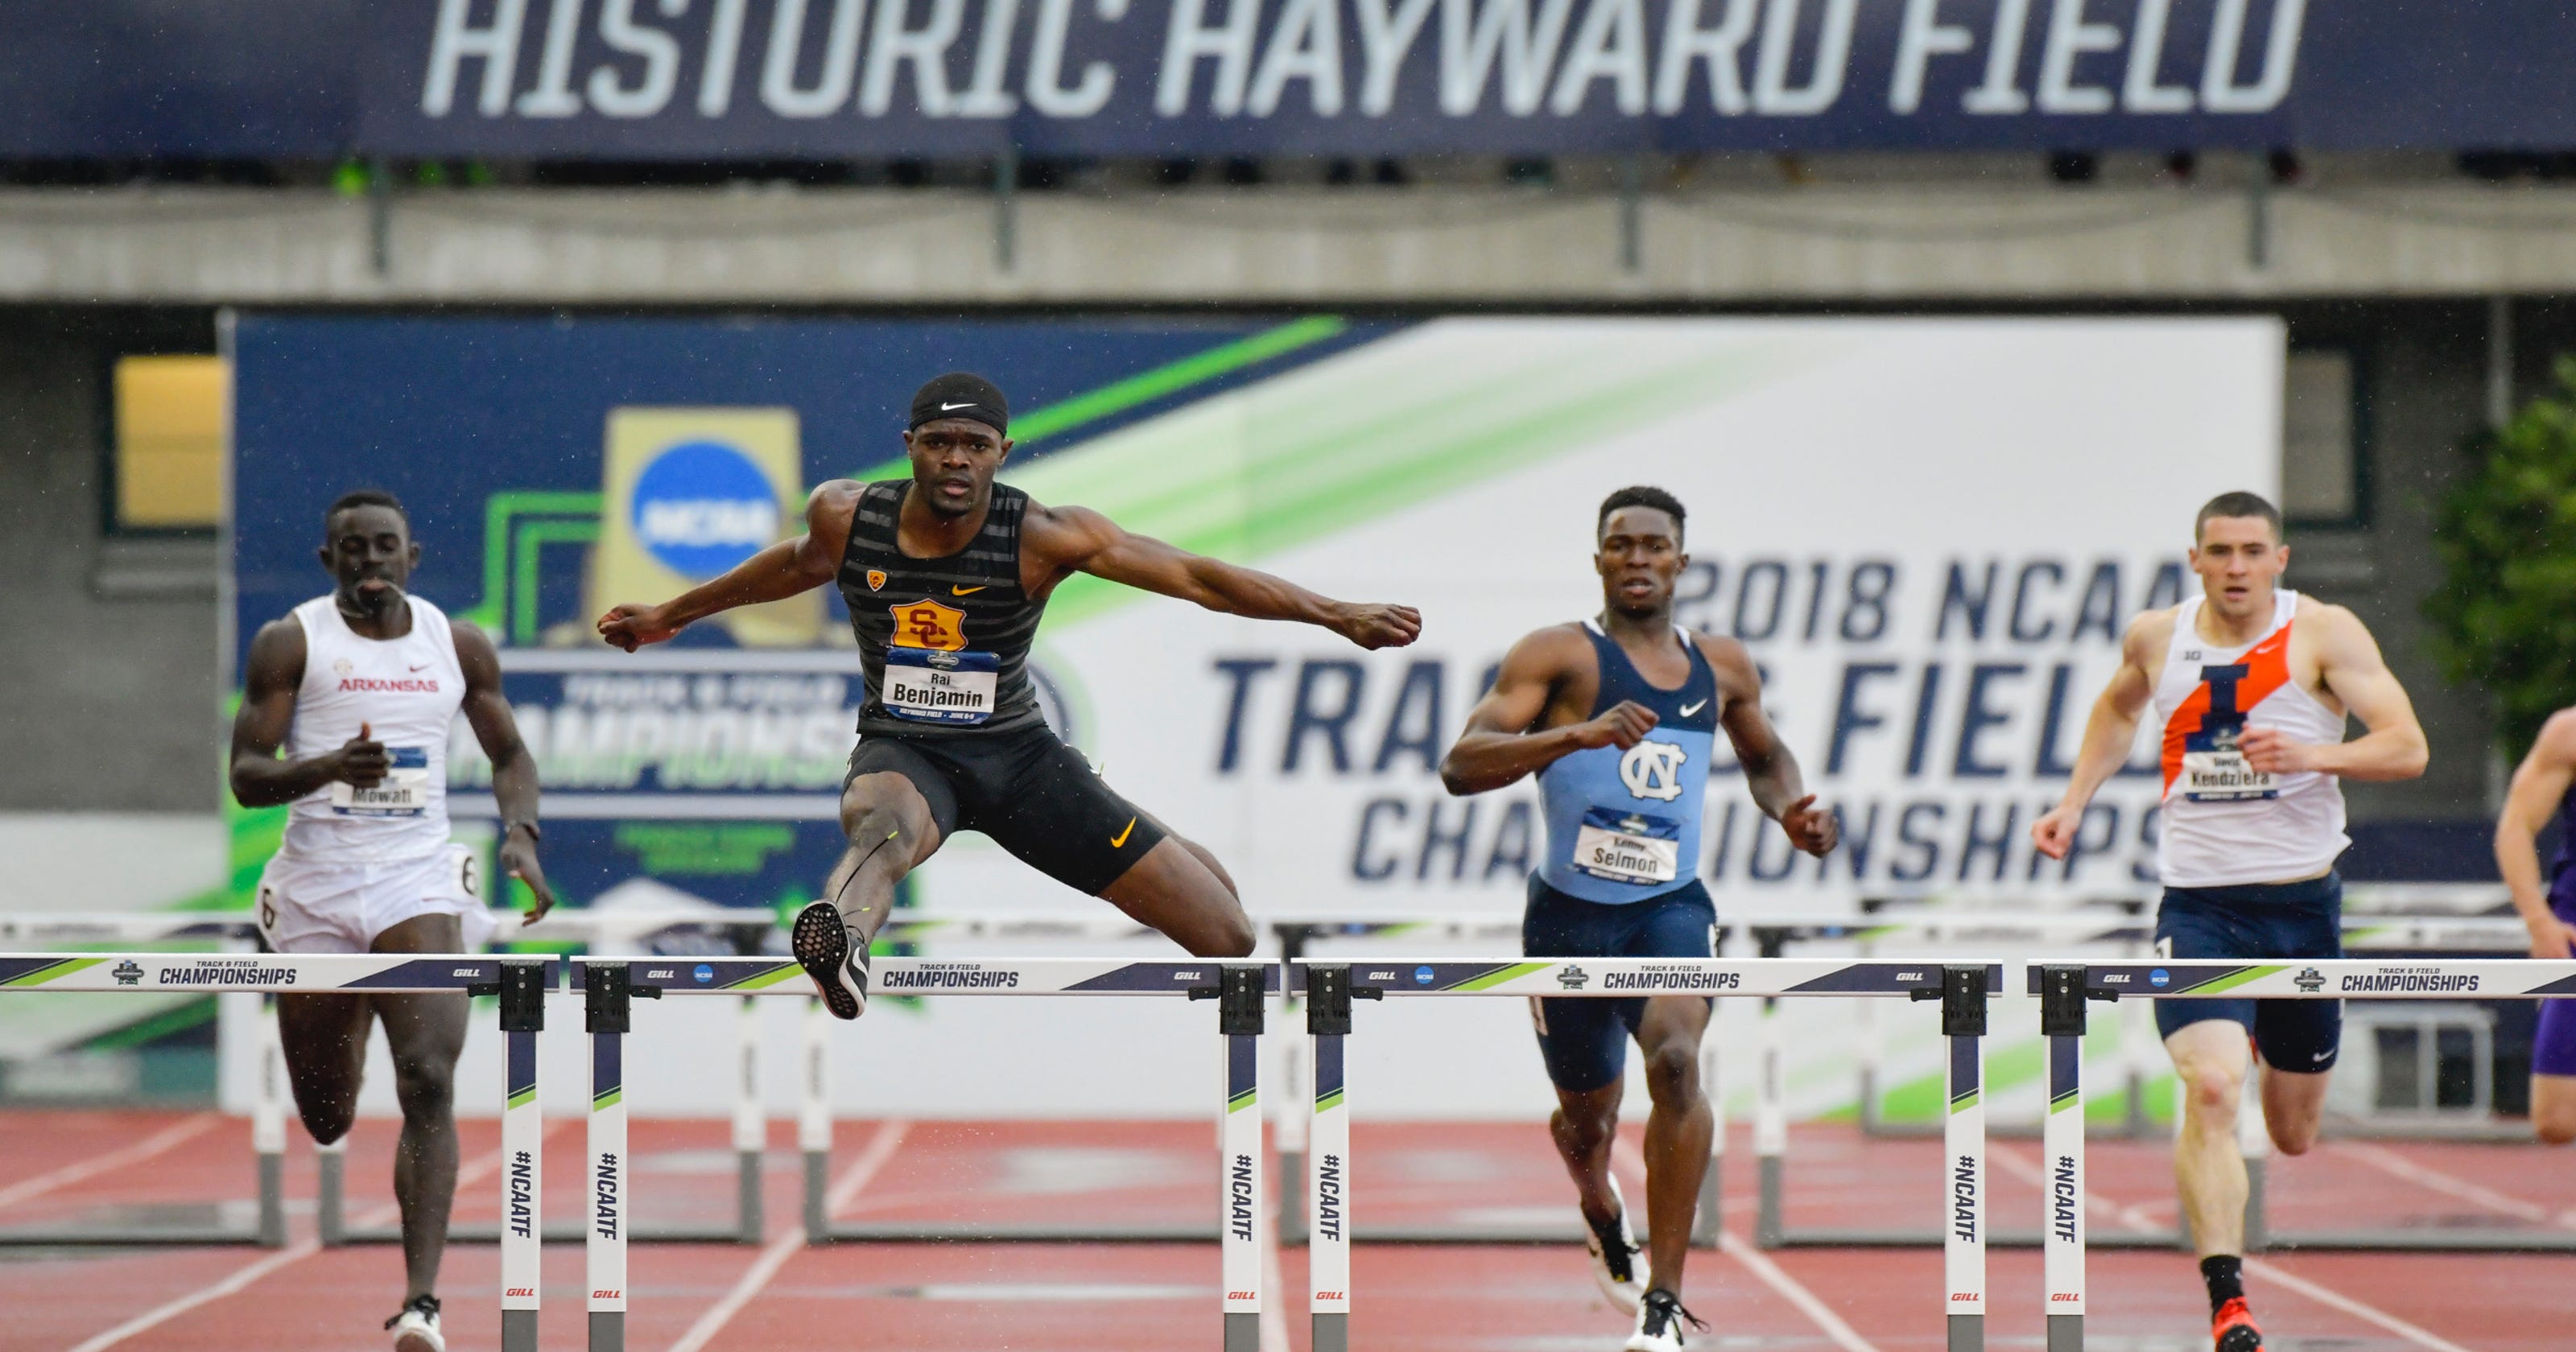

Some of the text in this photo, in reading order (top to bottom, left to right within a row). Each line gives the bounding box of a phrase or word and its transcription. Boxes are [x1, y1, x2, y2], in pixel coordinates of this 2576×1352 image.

[419, 0, 2308, 118] HISTORIC HAYWARD FIELD
[1674, 559, 1897, 643] 2018
[339, 678, 440, 693] ARKANSAS
[931, 673, 952, 686] Rai
[893, 683, 983, 707] Benjamin
[1212, 657, 1499, 774] TRA
[1823, 661, 2162, 777] FIEL
[1594, 847, 1657, 873] Selmon
[159, 968, 297, 984] CHAMPIONSHIPS
[452, 969, 480, 977] GILL
[647, 971, 675, 979] GILL
[883, 971, 1019, 987] CHAMPIONSHIPS
[1174, 971, 1201, 980] GILL
[1368, 971, 1396, 980] GILL
[1604, 973, 1740, 989] CHAMPIONSHIPS
[1895, 972, 1923, 981] GILL
[2103, 975, 2131, 983] GILL
[2341, 975, 2479, 991] CHAMPIONSHIPS
[510, 1151, 531, 1239] #NCAATF
[597, 1152, 617, 1240] #NCAATF
[1232, 1154, 1252, 1242] #NCAATF
[1319, 1154, 1340, 1242] #NCAATF
[1955, 1155, 1975, 1243] #NCAATF
[2054, 1156, 2075, 1243] #NCAATF
[506, 1288, 534, 1296] GILL
[592, 1290, 621, 1299] GILL
[1228, 1292, 1256, 1300] GILL
[1315, 1292, 1344, 1300] GILL
[1951, 1293, 1979, 1301] GILL
[2050, 1293, 2079, 1301] GILL
